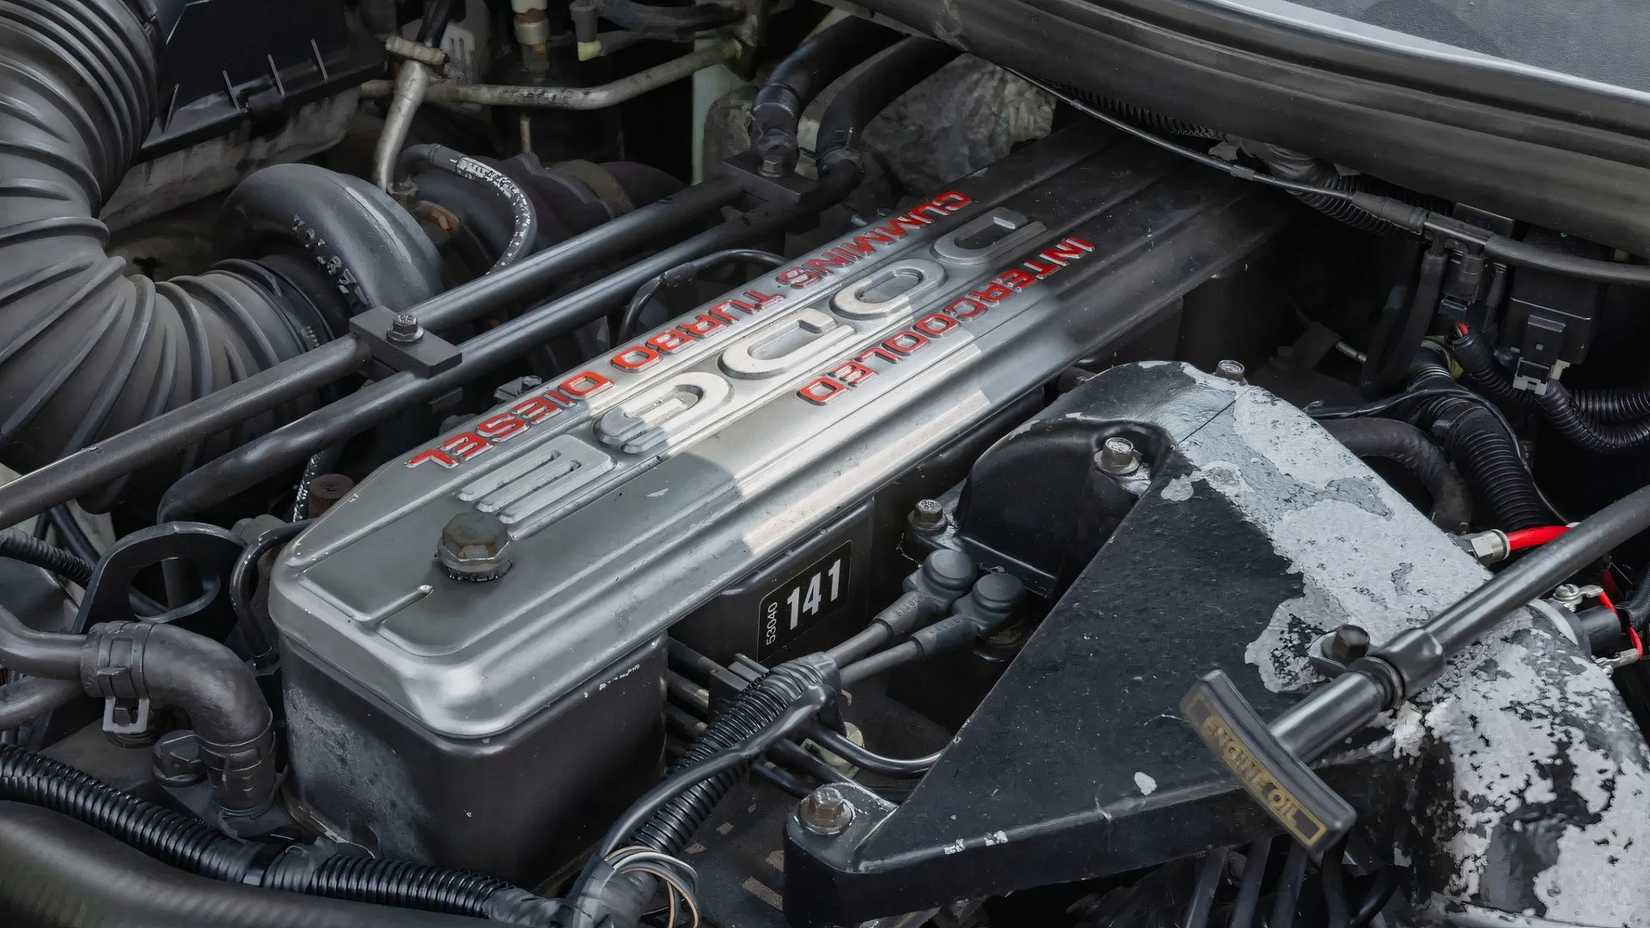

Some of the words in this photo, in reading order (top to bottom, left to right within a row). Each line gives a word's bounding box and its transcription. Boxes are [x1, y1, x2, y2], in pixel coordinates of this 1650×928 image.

[777, 190, 973, 289] CUMMINS
[458, 206, 1048, 523] DODGE
[611, 288, 785, 371] TURBO
[798, 236, 1096, 405] INTERCOOLED
[406, 371, 614, 468] DIESEL
[765, 602, 778, 646] 53040
[787, 559, 841, 631] 141
[1267, 787, 1299, 823] OIL
